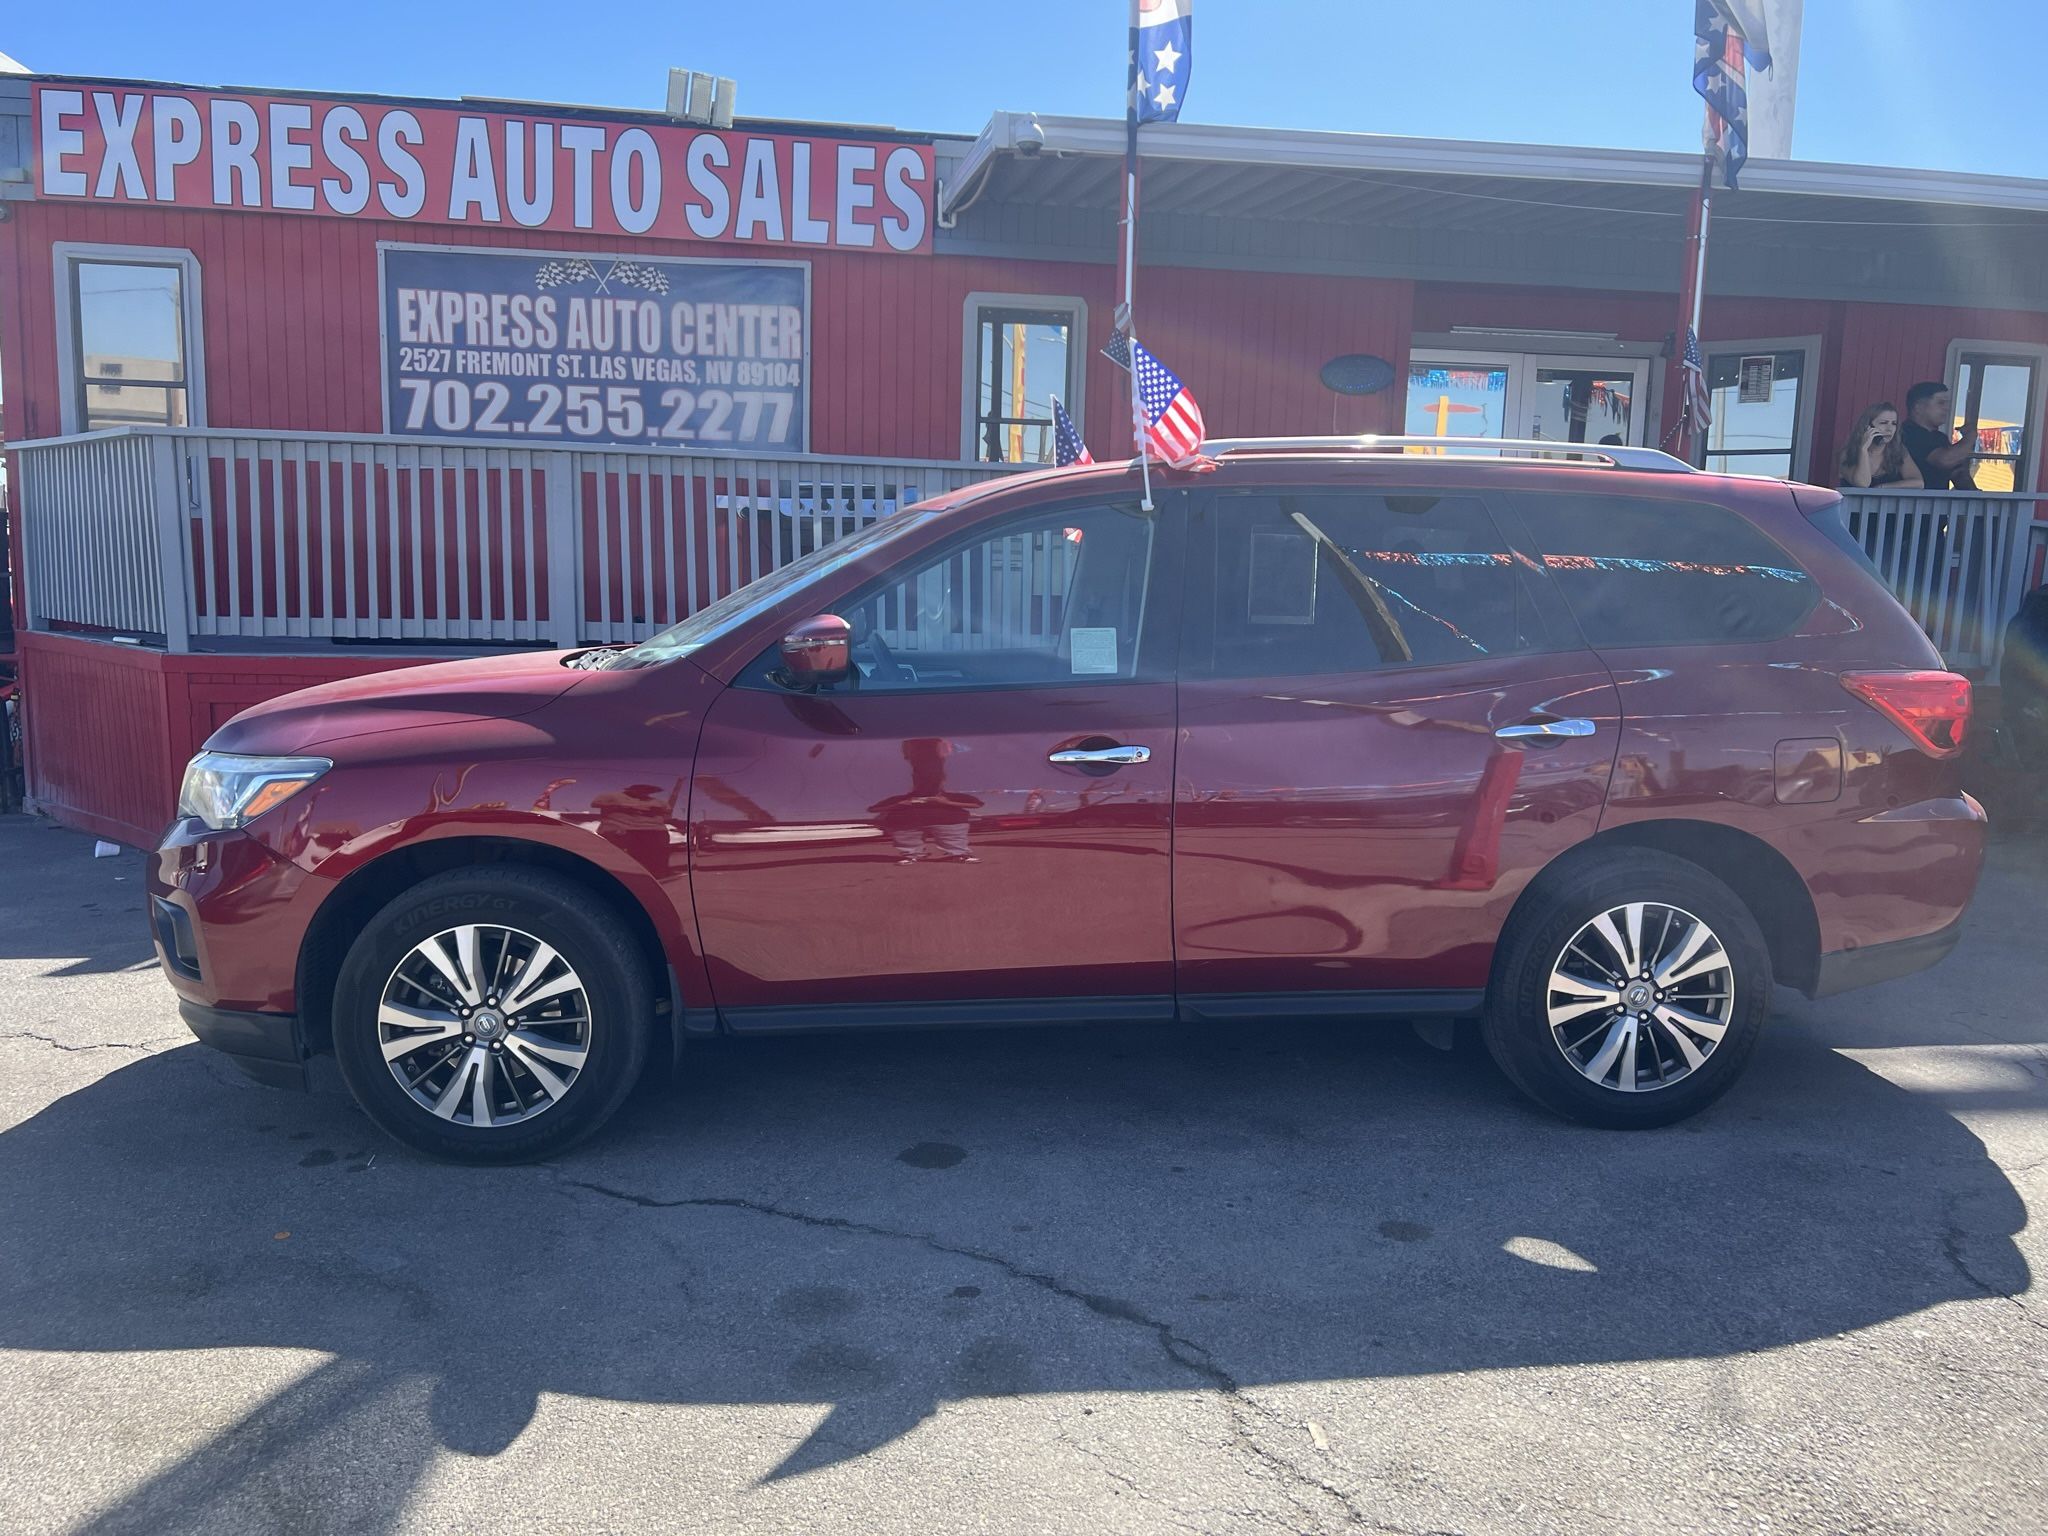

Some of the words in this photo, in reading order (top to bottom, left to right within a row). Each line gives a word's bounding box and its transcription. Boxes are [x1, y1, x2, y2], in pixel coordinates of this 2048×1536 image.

[39, 88, 427, 219] EXPRESS
[448, 116, 663, 234] AUTO
[684, 133, 926, 251] SALES
[397, 287, 558, 349] EXPRESS
[567, 297, 660, 354] AUTO
[670, 302, 801, 359] CENTER
[400, 348, 450, 373] 2527
[456, 350, 551, 377] FREMONT
[557, 354, 585, 378] ST.
[590, 356, 627, 381] LAS
[631, 358, 701, 385] VEGAS,
[705, 361, 731, 384] NV
[737, 362, 800, 388] 89104
[399, 379, 794, 443] 702.255.2277
